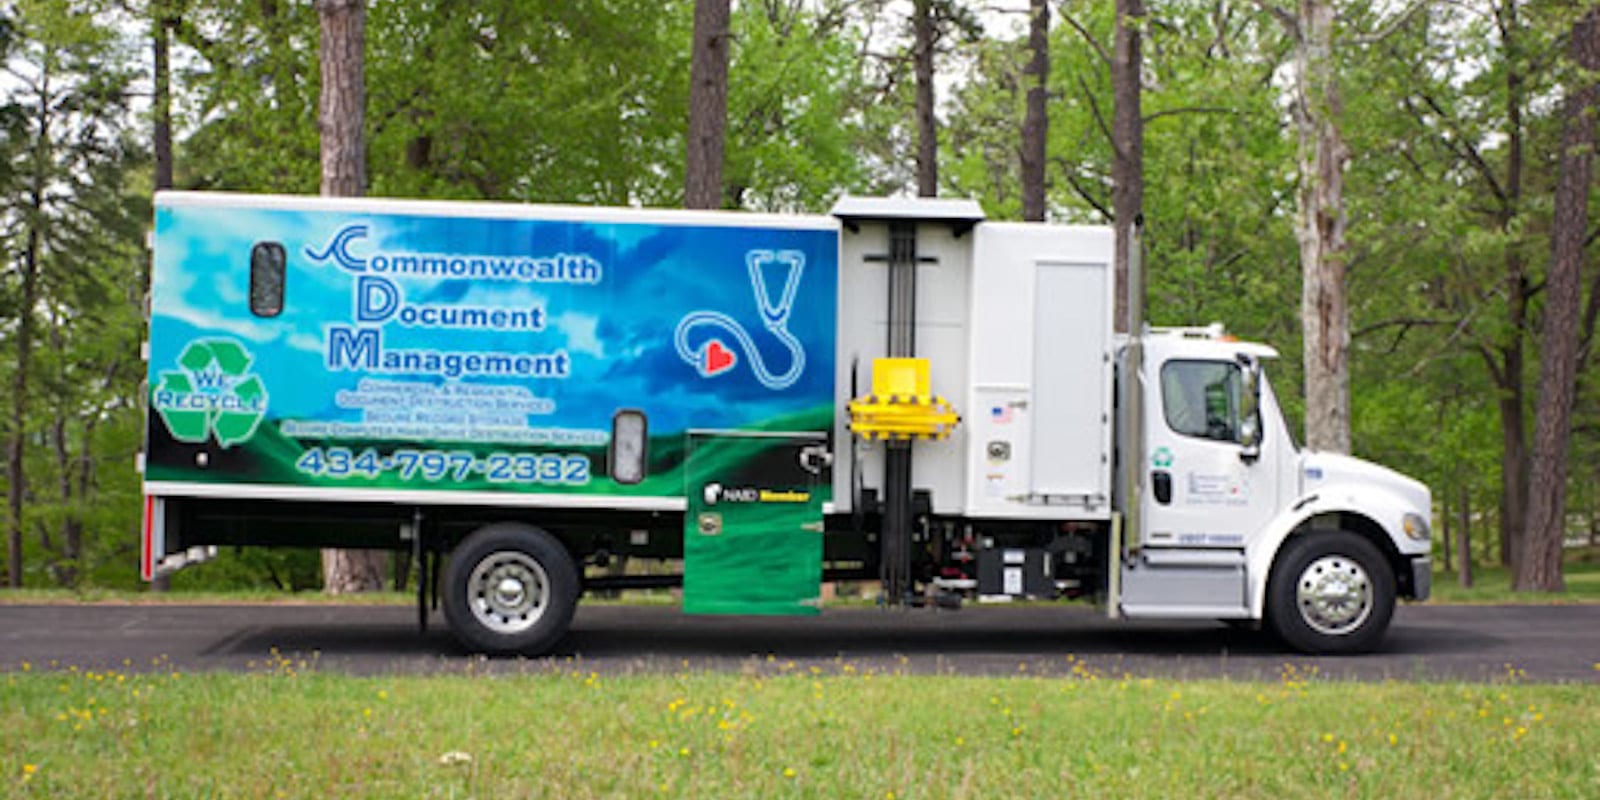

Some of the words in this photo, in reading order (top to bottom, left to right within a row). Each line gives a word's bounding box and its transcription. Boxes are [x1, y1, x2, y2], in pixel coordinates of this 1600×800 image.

[306, 225, 598, 281] Commonwealth
[357, 275, 543, 328] Document
[329, 327, 567, 376] Management
[193, 366, 230, 388] WE
[156, 391, 265, 412] RECYCLE
[299, 450, 589, 482] 434-797-2332
